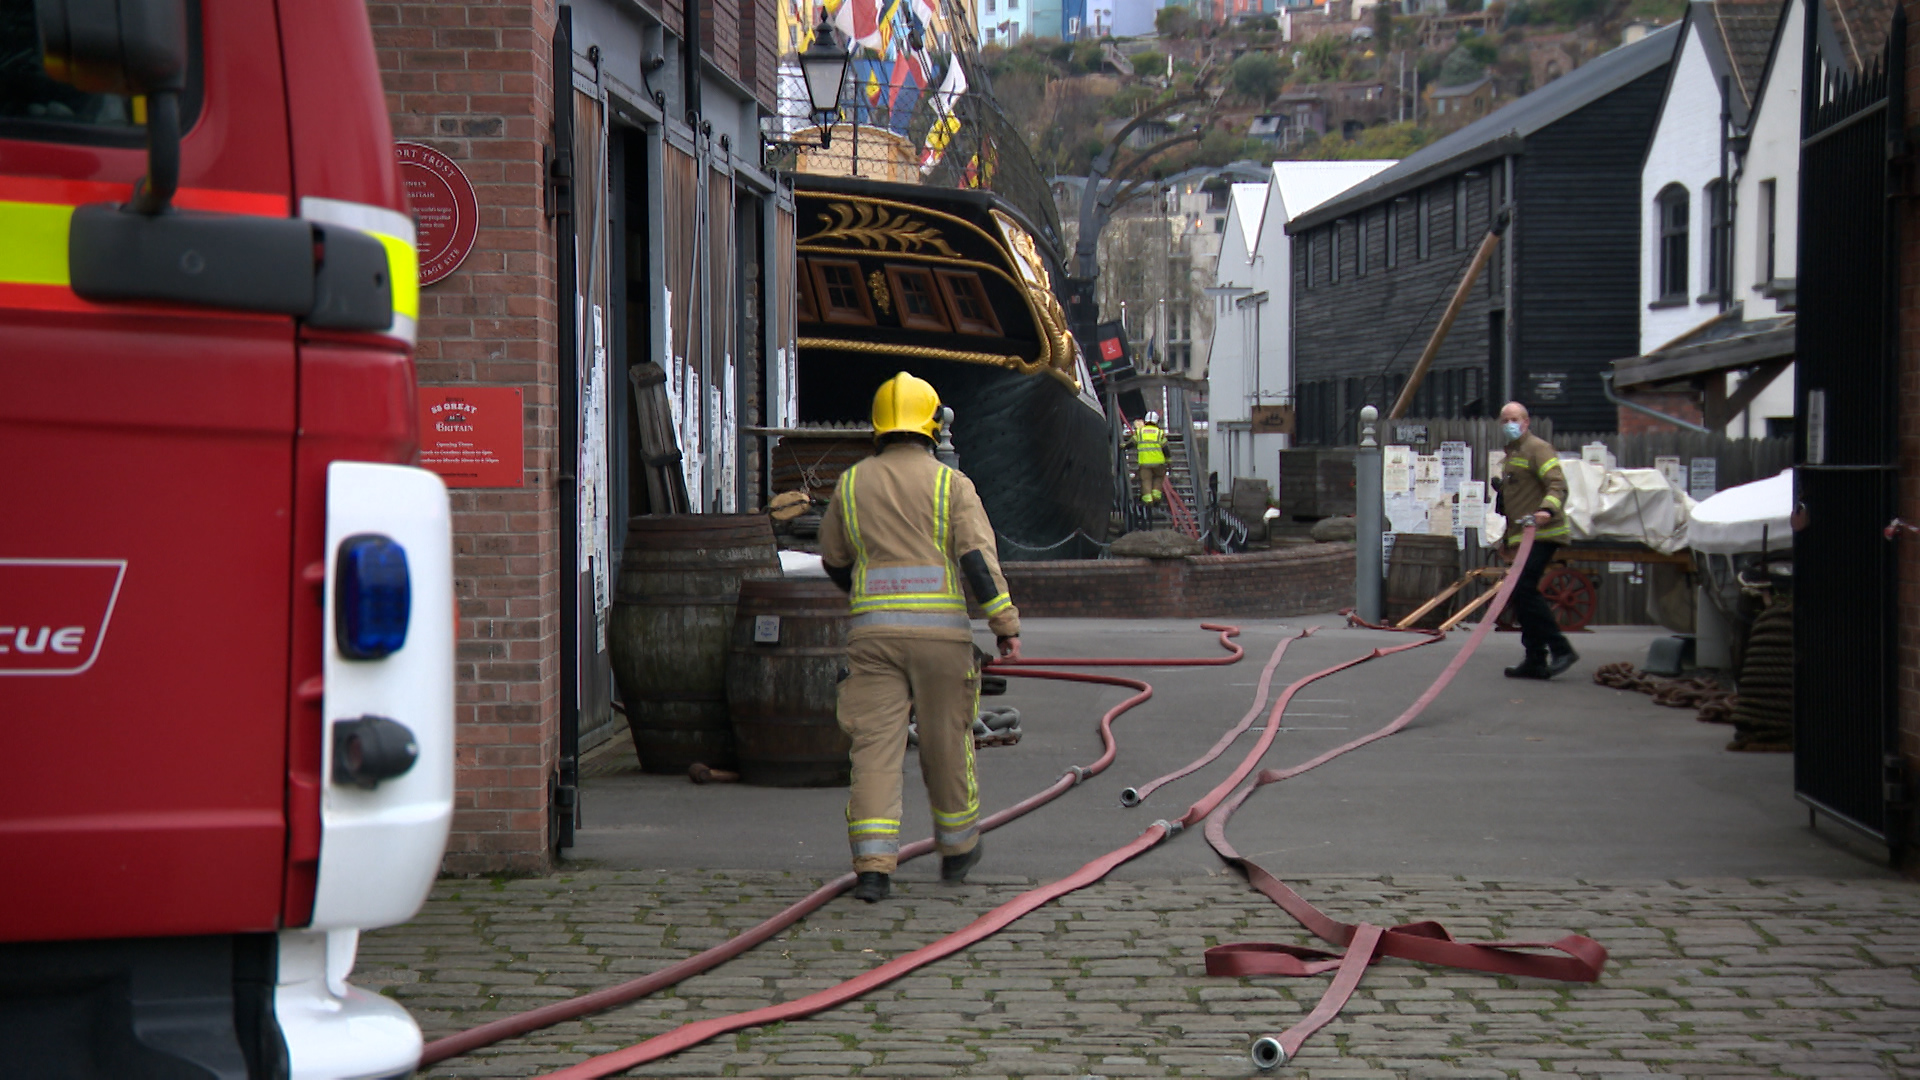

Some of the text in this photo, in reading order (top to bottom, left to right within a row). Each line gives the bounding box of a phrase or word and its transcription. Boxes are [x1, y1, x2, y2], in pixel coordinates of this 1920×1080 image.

[422, 152, 456, 178] TRUST
[443, 402, 478, 414] GREAT
[435, 421, 473, 432] BRITAIN
